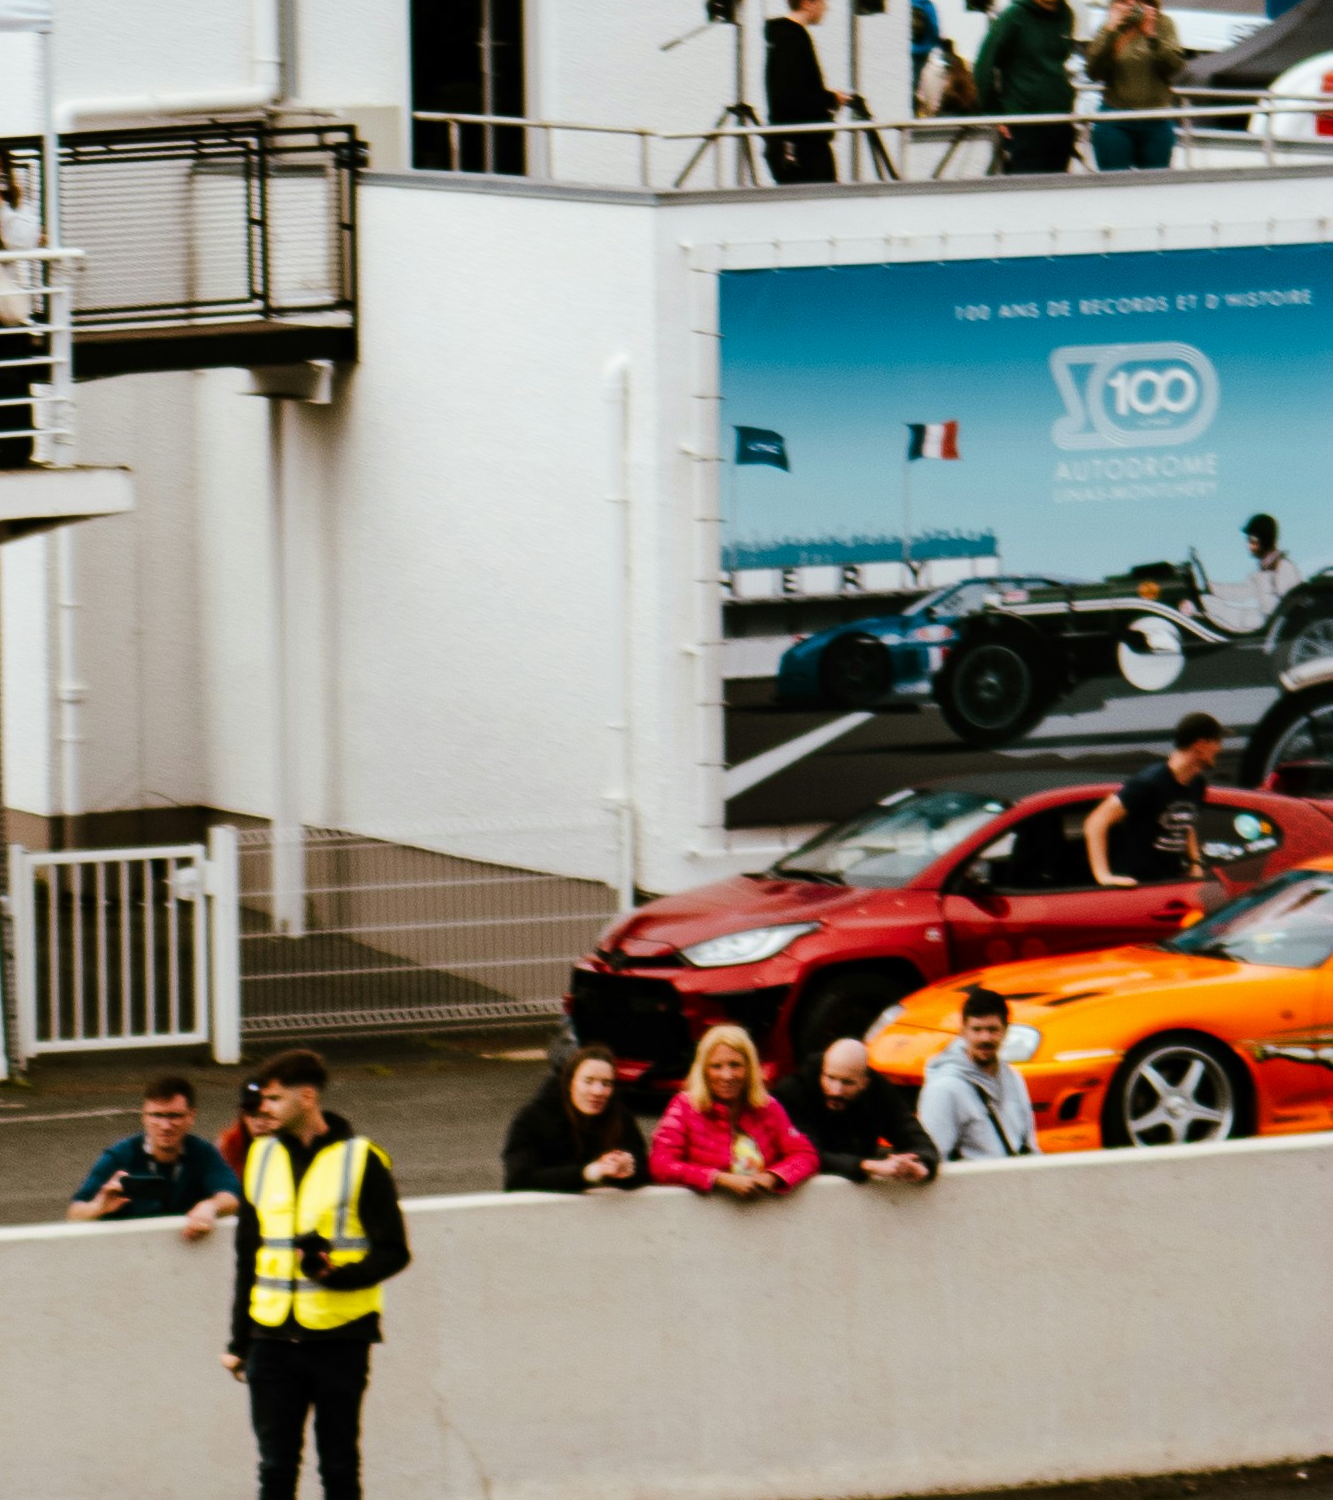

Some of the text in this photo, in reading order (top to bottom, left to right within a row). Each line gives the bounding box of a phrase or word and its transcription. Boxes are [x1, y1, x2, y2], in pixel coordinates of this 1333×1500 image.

[955, 304, 991, 321] 100
[998, 301, 1040, 319] ANS
[1046, 298, 1071, 317] DE
[1079, 294, 1169, 315] RECORDS
[1107, 367, 1197, 417] 100
[1054, 454, 1218, 480] AUTODROME
